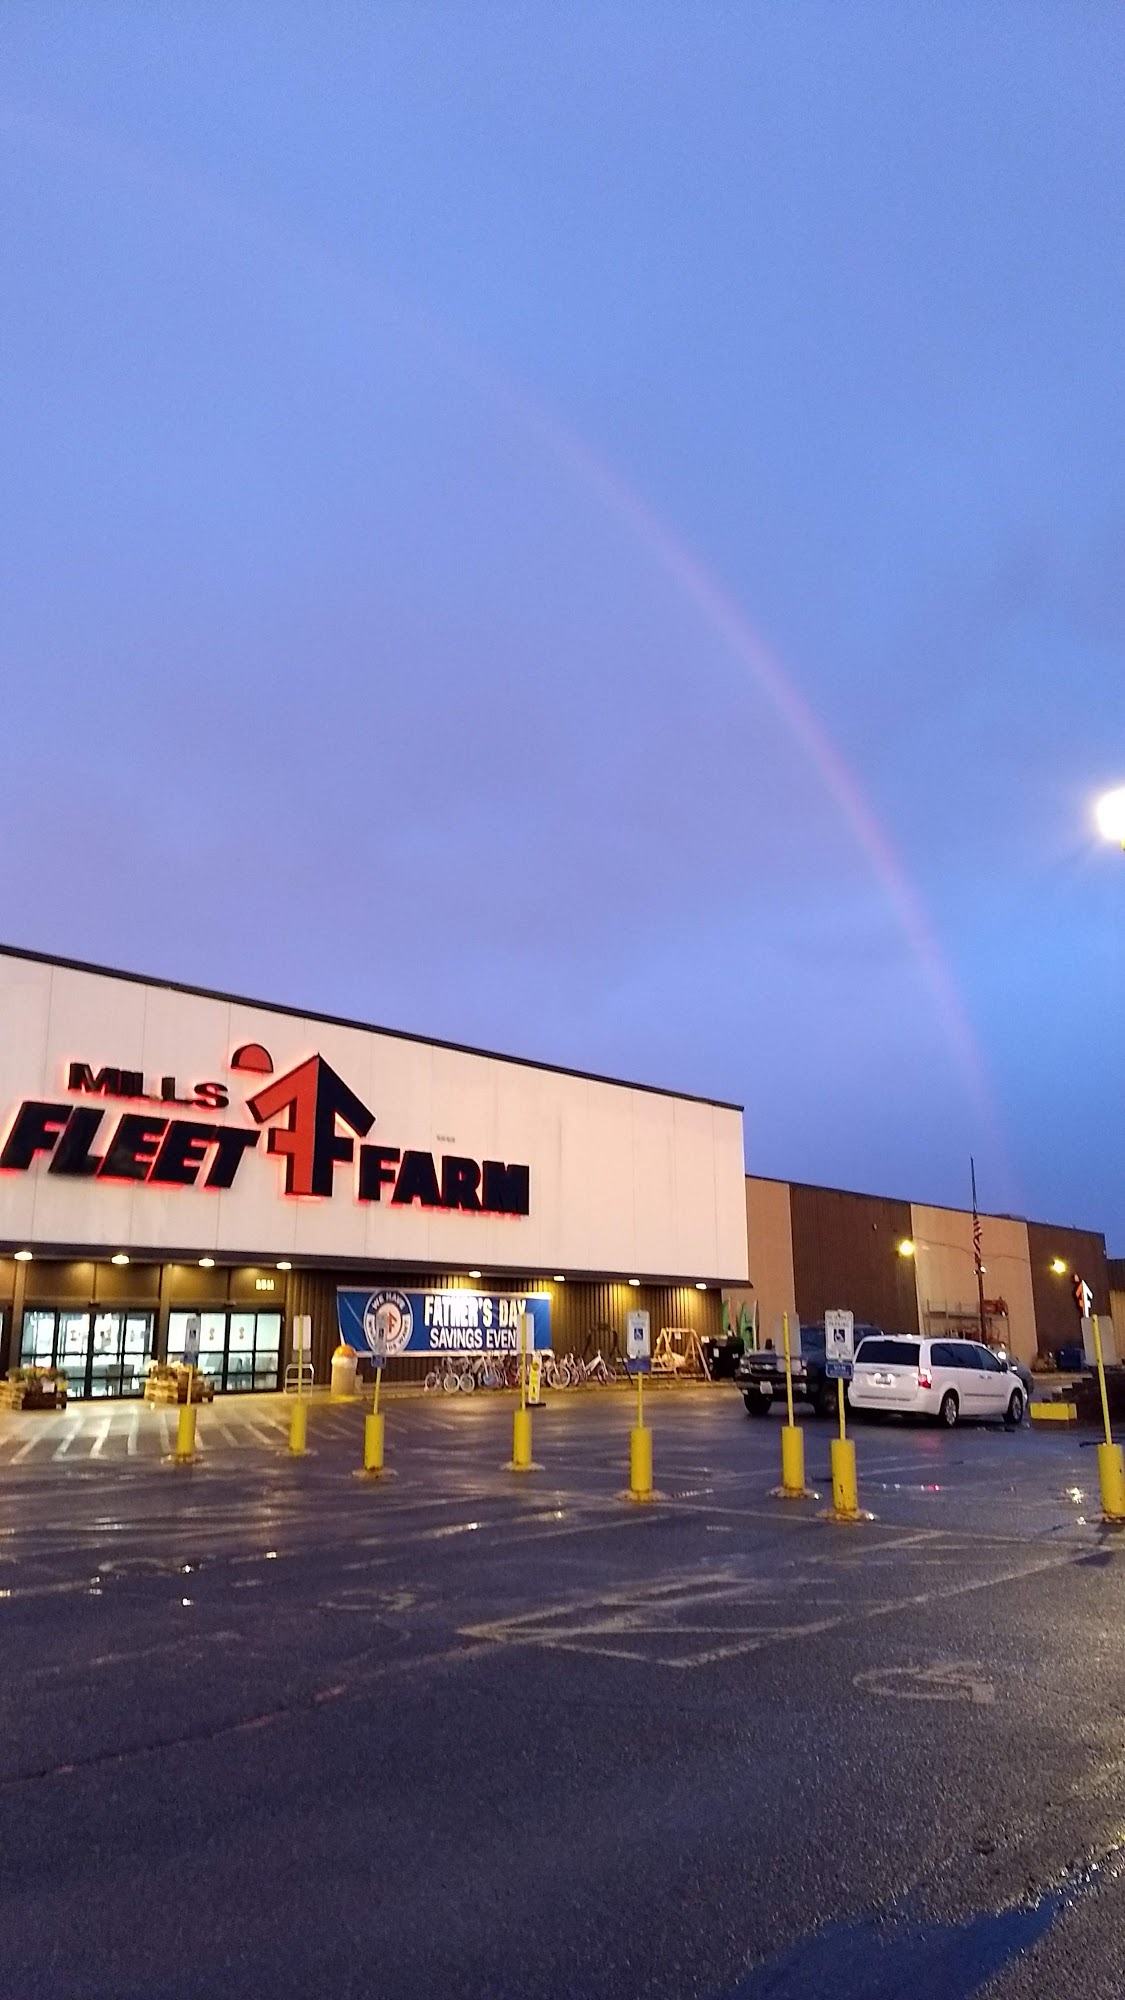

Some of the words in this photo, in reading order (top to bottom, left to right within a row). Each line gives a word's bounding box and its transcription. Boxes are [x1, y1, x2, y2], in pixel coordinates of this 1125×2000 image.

[68, 1063, 229, 1108] MILLS
[0, 1101, 261, 1188] FLEET
[359, 1144, 530, 1215] FARM
[424, 1295, 493, 1327] FATHER'S
[499, 1299, 527, 1328] DAY
[429, 1327, 483, 1348] SAVINGS
[486, 1328, 518, 1349] EVEN
